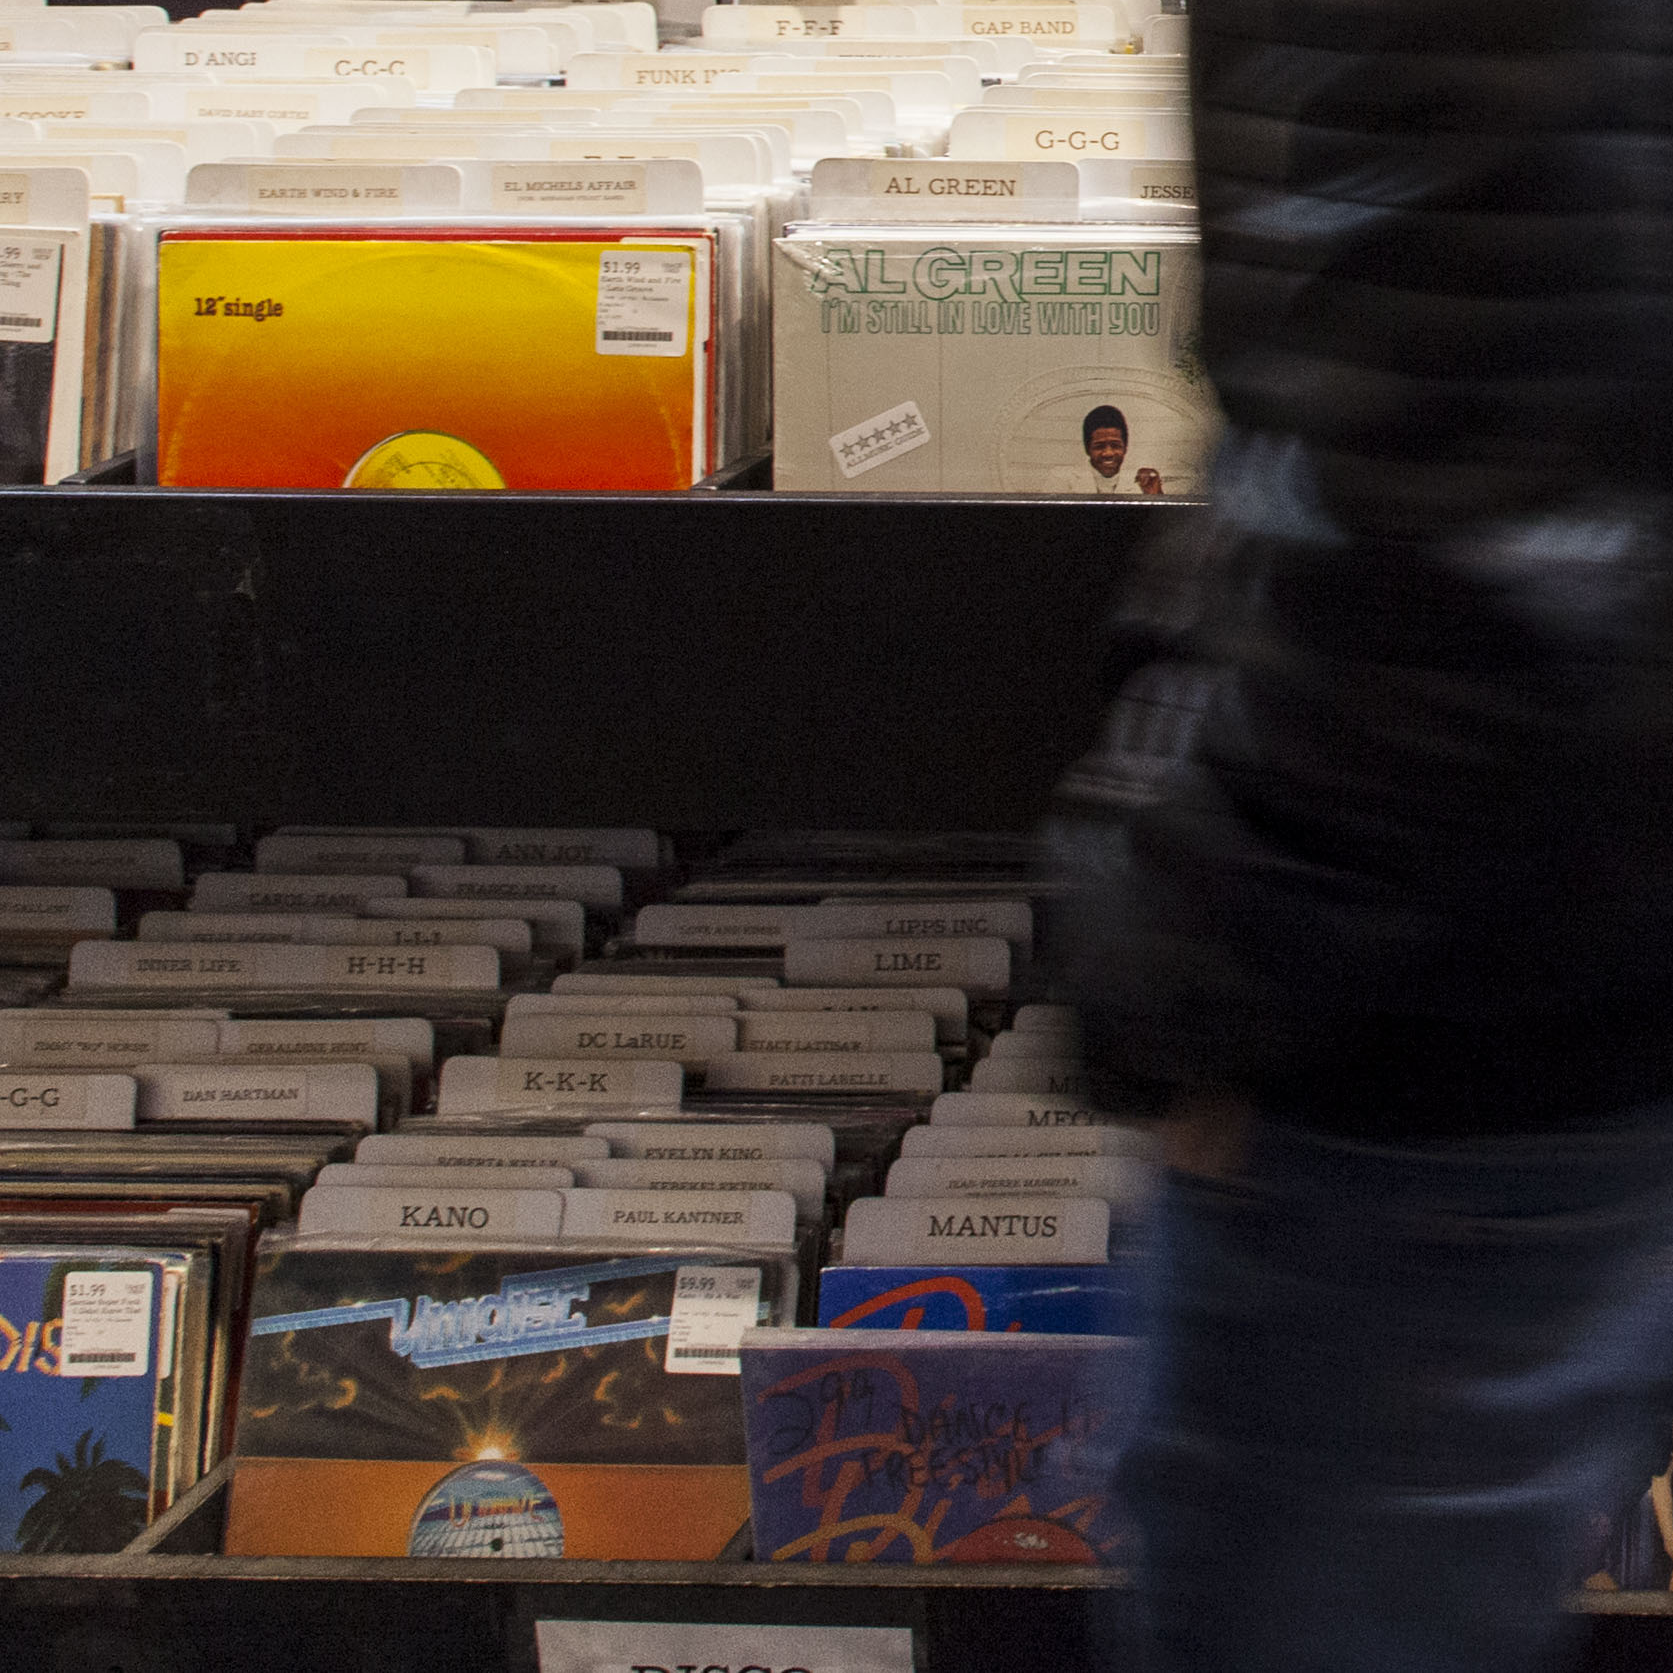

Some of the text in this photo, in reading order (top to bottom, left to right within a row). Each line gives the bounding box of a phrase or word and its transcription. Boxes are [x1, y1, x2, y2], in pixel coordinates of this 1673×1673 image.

[776, 20, 845, 35] F-F-F
[972, 21, 1075, 34] GAP BAND
[335, 61, 405, 77] C-C-C
[1035, 130, 1120, 151] G-G-G
[259, 187, 399, 199] EARTH WIND & FIRE
[885, 178, 1016, 196] AL GREEN
[811, 247, 1161, 303] AL GREEN
[347, 957, 426, 974] H-H-H
[874, 953, 942, 972] LIME
[524, 1072, 608, 1092] K-K-K
[401, 1206, 489, 1228] KANO
[613, 1211, 744, 1224] PAUL KANTNER
[928, 1215, 1058, 1238] MANTUS
